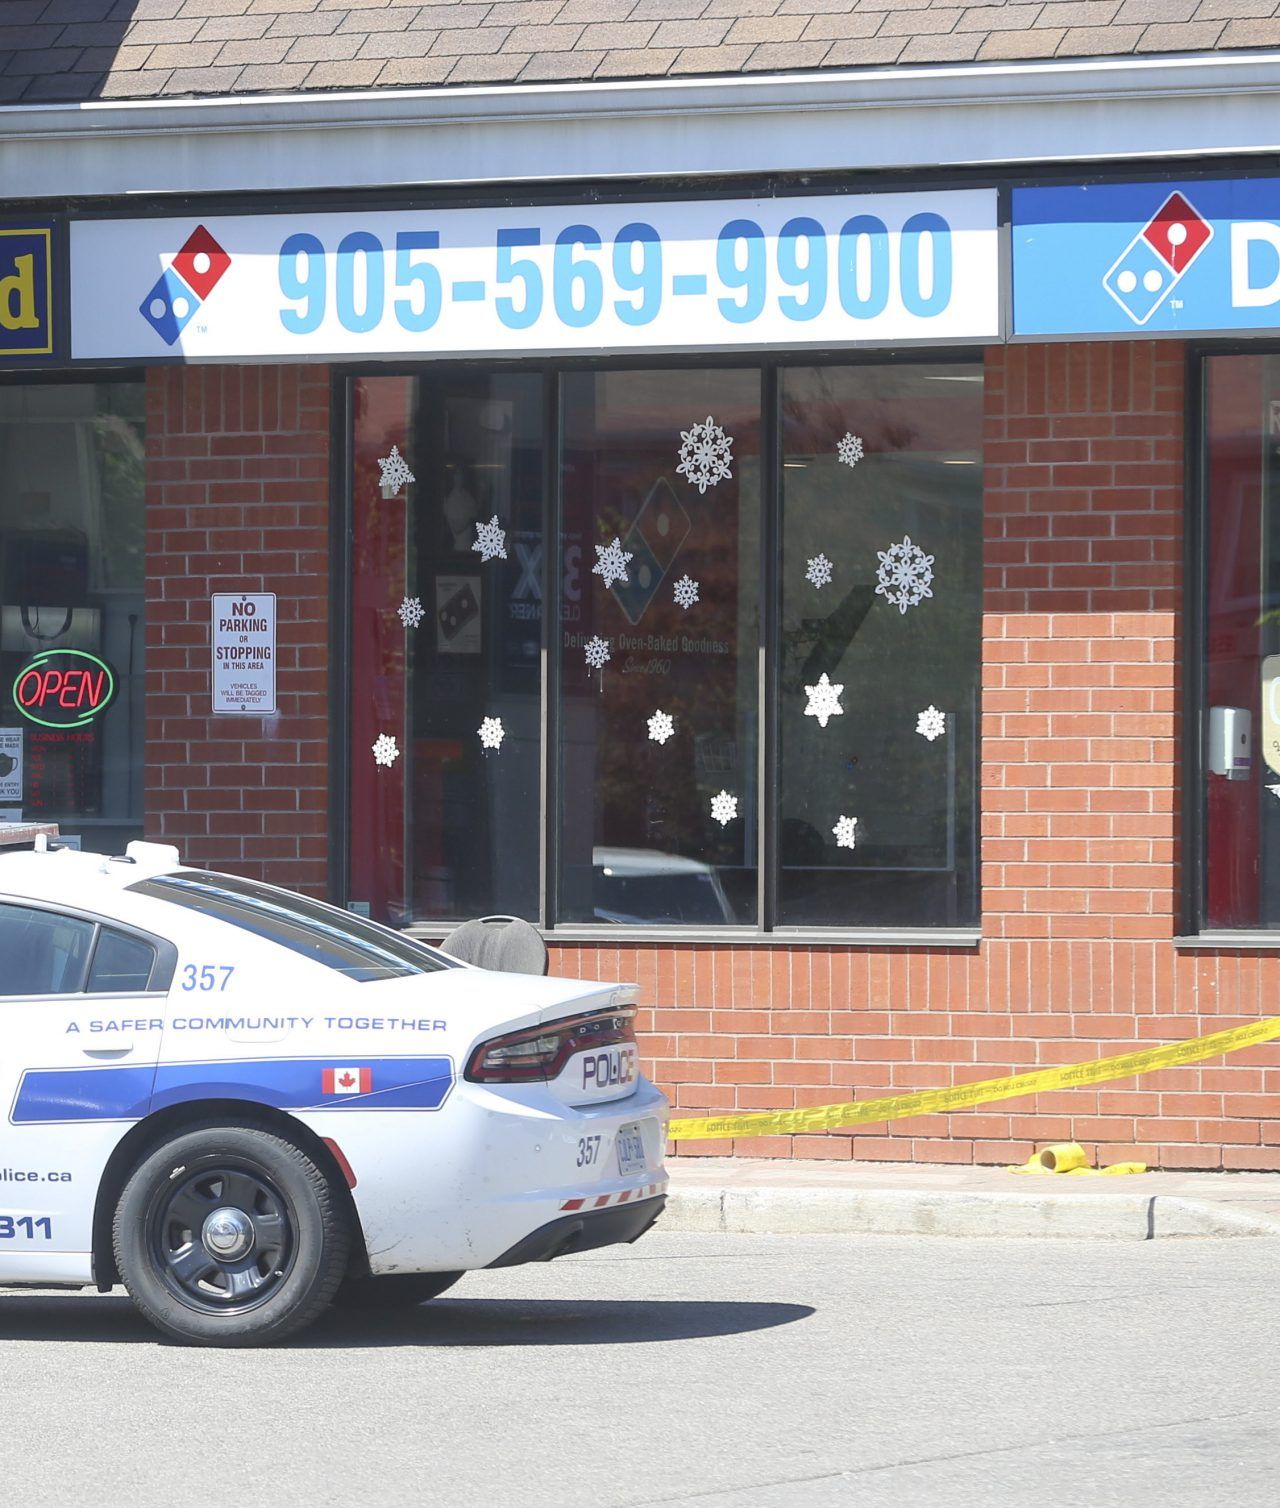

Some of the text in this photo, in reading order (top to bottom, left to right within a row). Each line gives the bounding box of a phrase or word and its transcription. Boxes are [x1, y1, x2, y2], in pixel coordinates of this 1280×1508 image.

[277, 212, 953, 334] 905-569-9900
[232, 602, 256, 616] NO
[220, 619, 267, 632] PARKING
[239, 635, 248, 643] OR
[619, 633, 678, 652] Oven-Baked
[681, 636, 729, 654] Goodness
[216, 647, 271, 660] STOPPING
[223, 662, 264, 670] IN THIS AREA
[19, 671, 104, 707] OPEN
[182, 964, 235, 992] 357
[65, 1017, 447, 1034] A SAFER COMMUNITY TOGETHER
[582, 1049, 634, 1090] POLICE
[576, 1135, 601, 1168] 357
